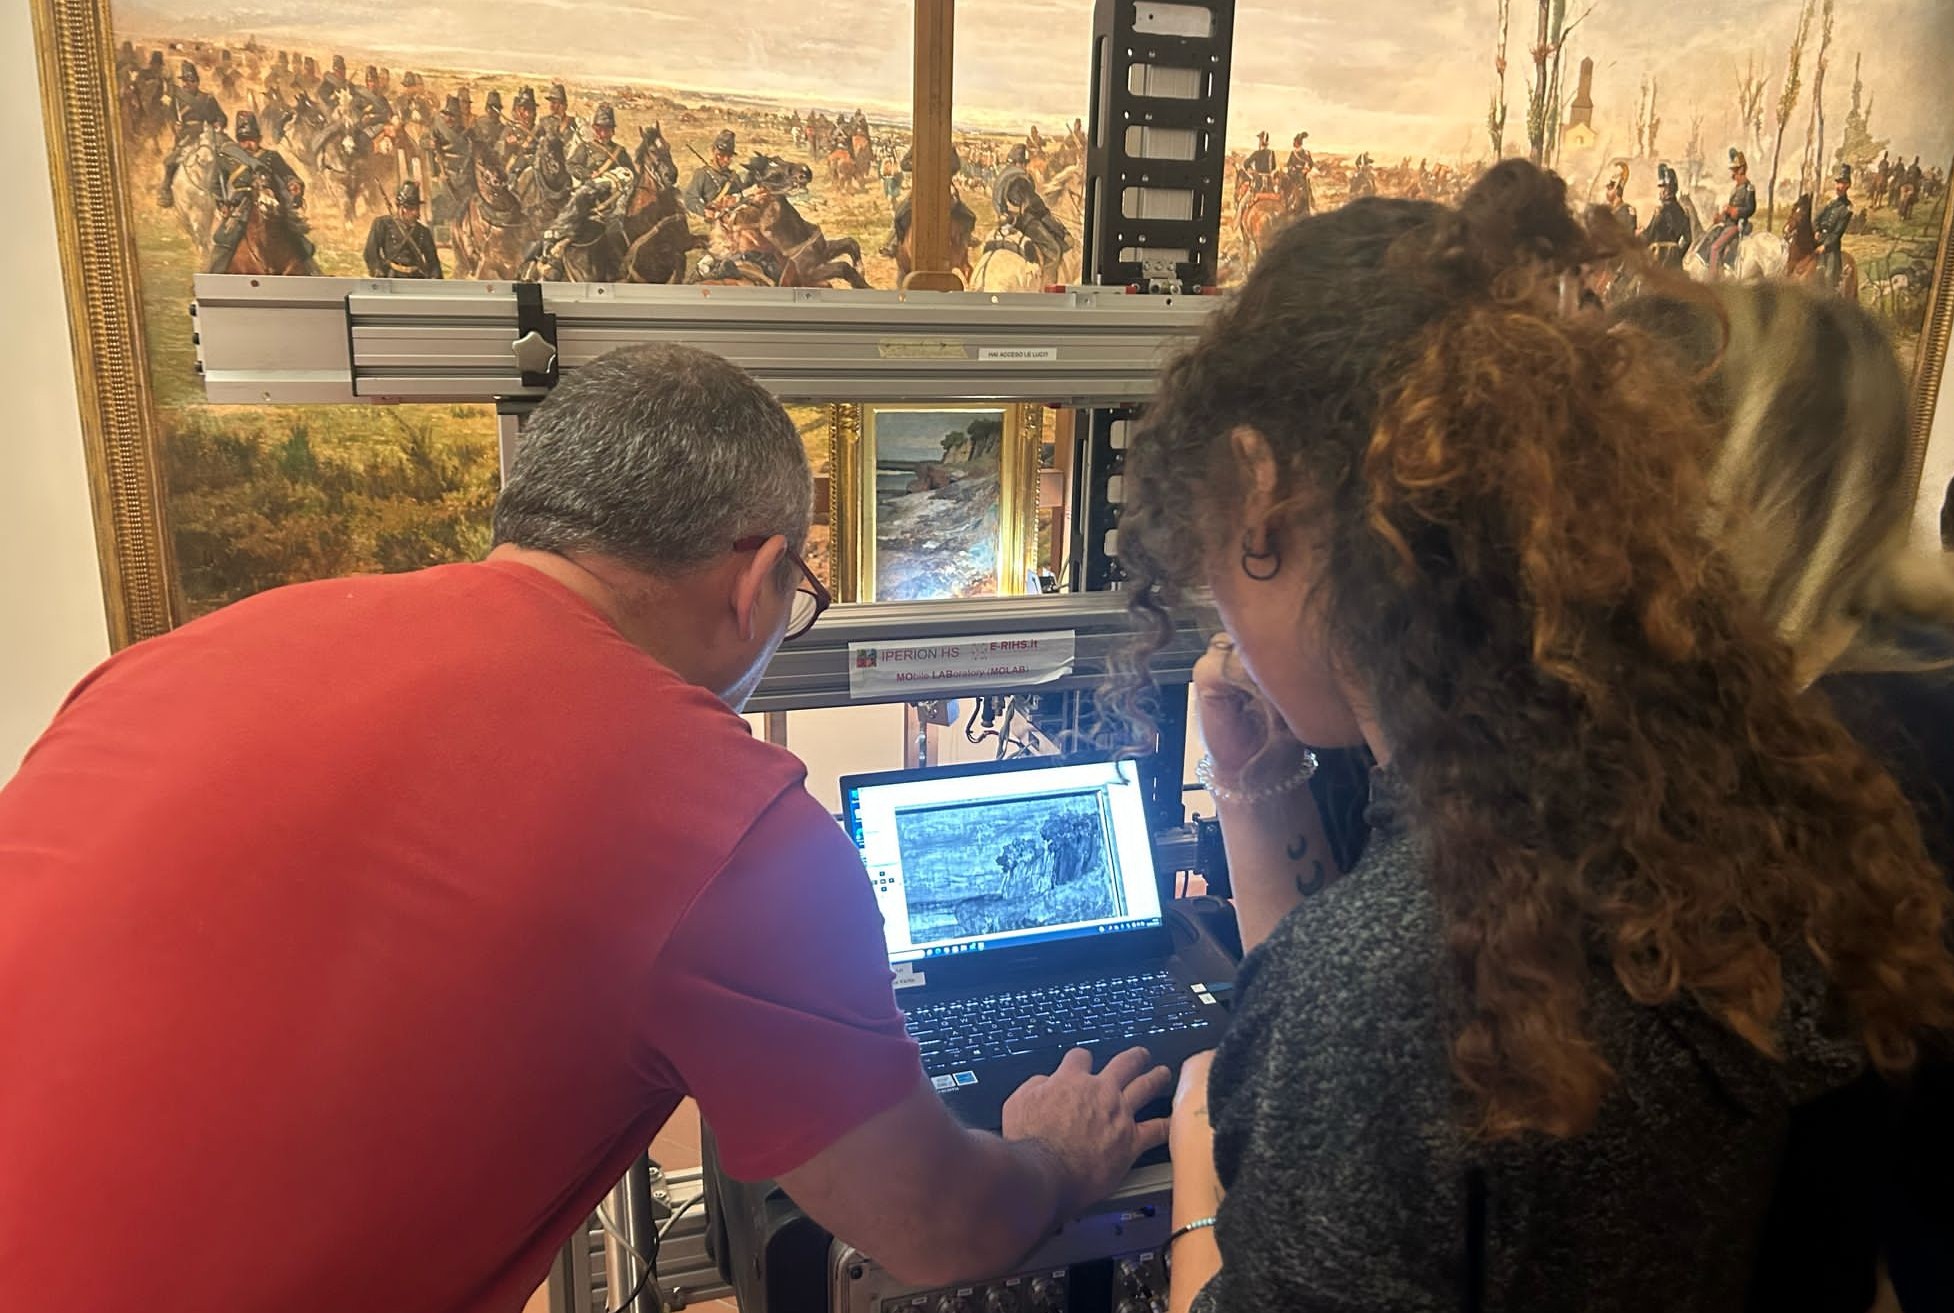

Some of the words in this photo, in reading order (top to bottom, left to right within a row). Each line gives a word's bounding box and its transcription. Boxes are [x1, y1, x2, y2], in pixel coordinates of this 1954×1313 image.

[881, 648, 937, 662] IPERION
[941, 647, 960, 658] HS
[896, 671, 929, 682] MObile
[932, 669, 984, 680] LABoratory
[987, 665, 1030, 677] (MOLAB)
